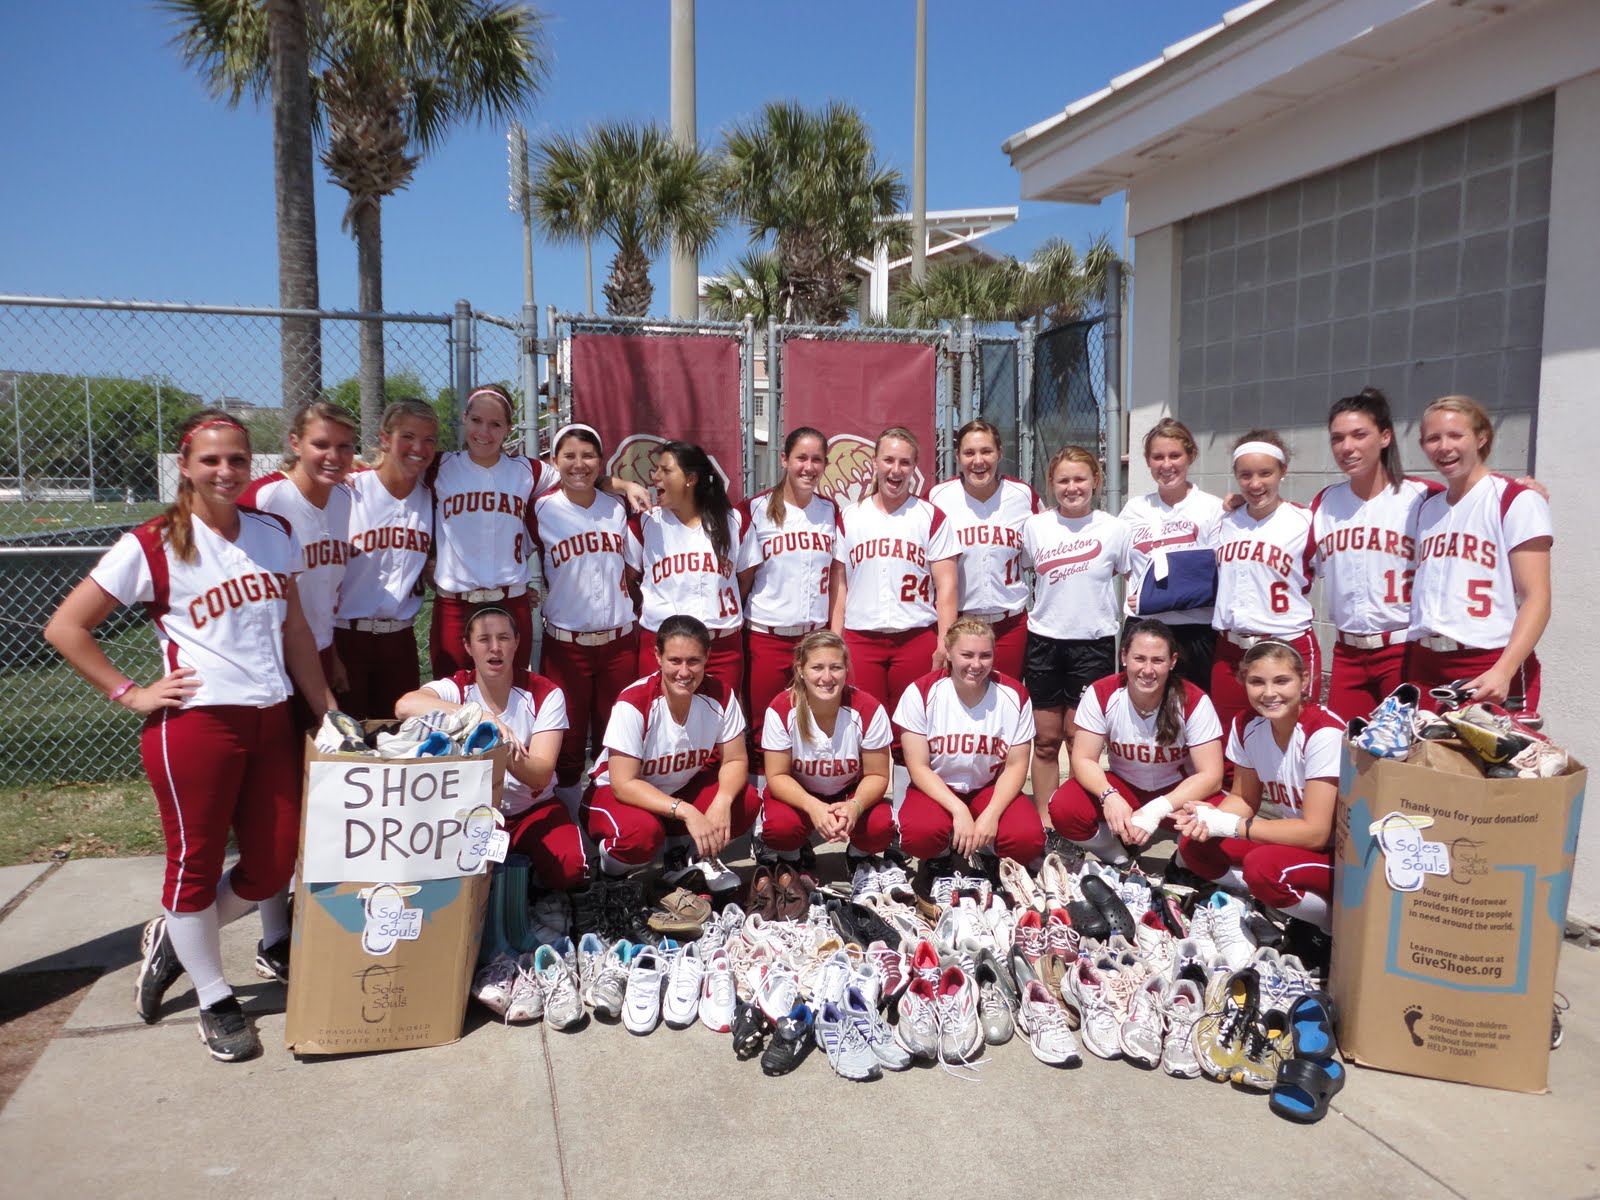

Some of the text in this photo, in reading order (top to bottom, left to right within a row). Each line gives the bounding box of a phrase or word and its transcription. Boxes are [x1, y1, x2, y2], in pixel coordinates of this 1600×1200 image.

[443, 491, 526, 520] COUGAR
[350, 526, 432, 558] COUGAR
[551, 531, 624, 569] COUGAR
[763, 531, 832, 561] COUGAR
[1317, 526, 1416, 562] COUGARS
[1419, 532, 1497, 569] UGARS
[849, 537, 926, 570] COUGARS
[1216, 540, 1294, 577] OUGARS
[652, 552, 734, 584] COUGARS
[1049, 561, 1089, 585] Softball
[901, 574, 931, 602] 24
[1270, 581, 1290, 613] 6
[1467, 580, 1493, 618] 5
[189, 572, 289, 629] COUGAR
[718, 586, 739, 618] 13
[927, 734, 1009, 760] COUGARS
[1111, 742, 1190, 763] OUGARS
[643, 749, 710, 776] OUGAR
[793, 759, 859, 777] OUGAR
[344, 767, 460, 809] SHOE
[1400, 798, 1539, 825] Thank you for your donation!
[345, 818, 462, 860] DROP
[471, 825, 505, 841] Soles
[481, 838, 490, 847] 4
[470, 844, 505, 860] Souls
[1395, 836, 1440, 853] Soles
[1401, 856, 1447, 873] Souls
[1411, 851, 1422, 861] 4
[1423, 887, 1441, 897] Your
[1443, 893, 1458, 901] gift
[377, 905, 417, 920] Soles
[1413, 899, 1449, 912] provides
[1451, 906, 1474, 917] HOPE
[1485, 911, 1512, 919] people
[378, 922, 418, 937] Souls
[390, 919, 400, 928] 4
[1419, 913, 1440, 922] need
[1442, 918, 1473, 930] around
[1410, 942, 1434, 954] Learn
[1435, 950, 1458, 959] more
[1459, 954, 1484, 962] about
[1412, 952, 1502, 979] GiveShoes.org
[372, 981, 405, 994] Soles
[372, 995, 407, 1008] Souls
[1431, 1013, 1445, 1022] 300
[1446, 1017, 1475, 1027] million
[1428, 1034, 1460, 1045] without
[1429, 1024, 1458, 1035] around
[1474, 1032, 1497, 1040] world
[1427, 1042, 1477, 1057] HELP TODAY!
